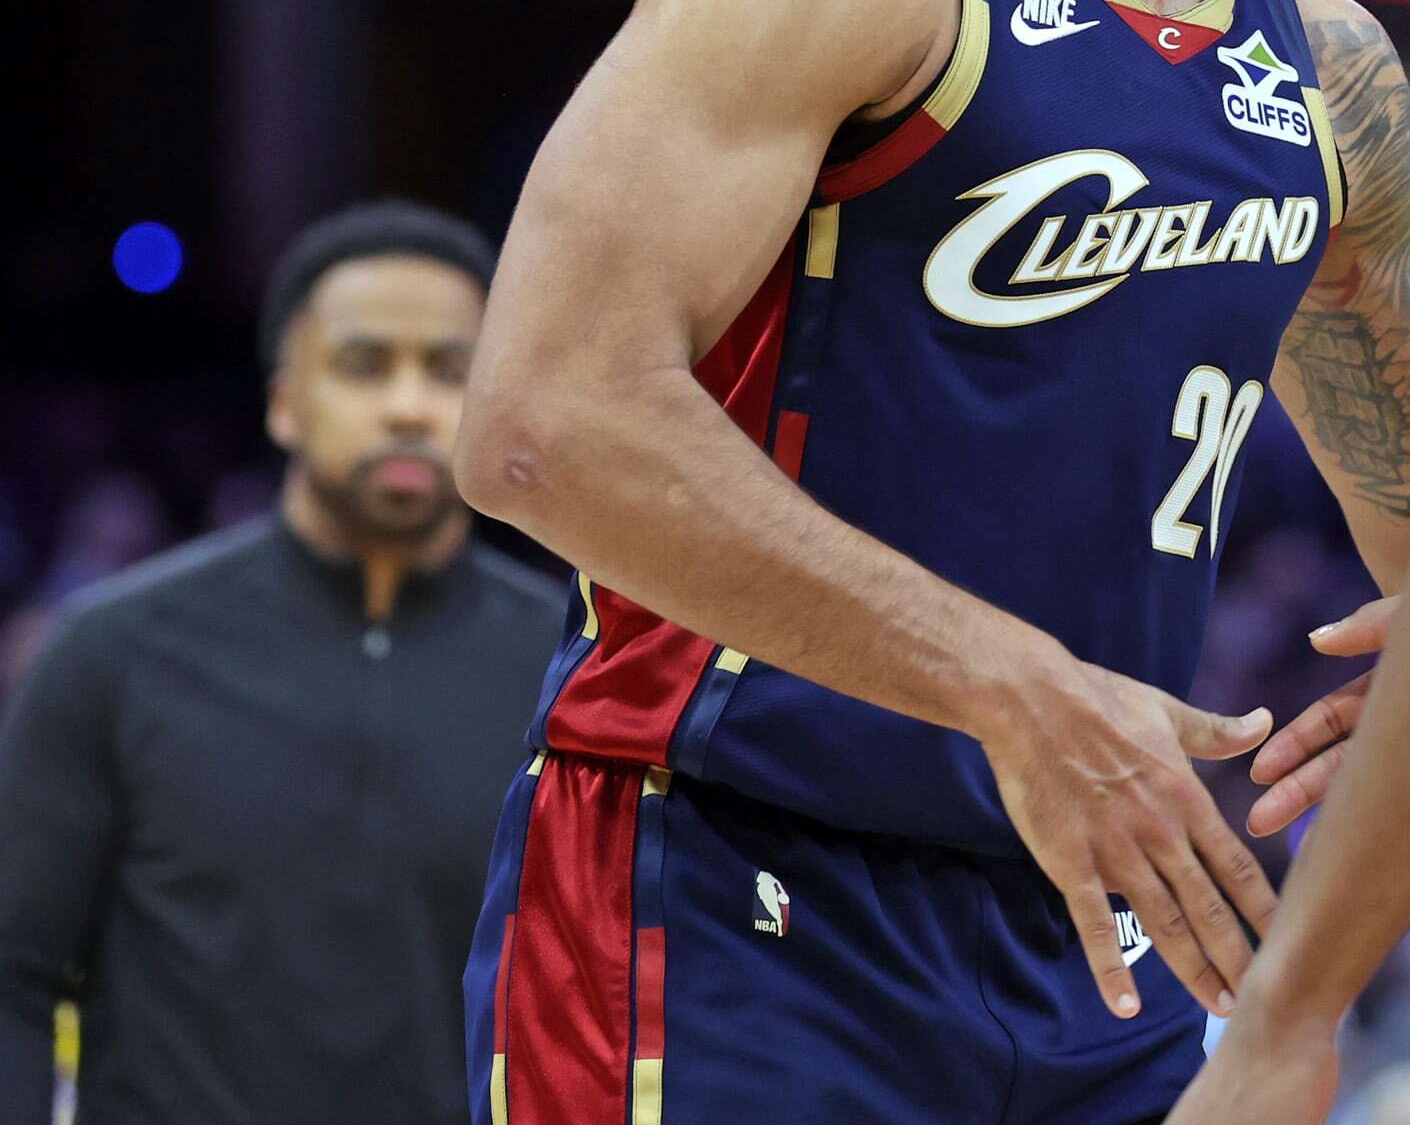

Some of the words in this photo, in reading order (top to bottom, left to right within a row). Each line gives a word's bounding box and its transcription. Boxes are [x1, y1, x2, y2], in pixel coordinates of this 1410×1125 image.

[1227, 94, 1308, 137] CLIFFS
[922, 148, 1320, 328] CLEVELAND
[754, 919, 778, 934] NBA
